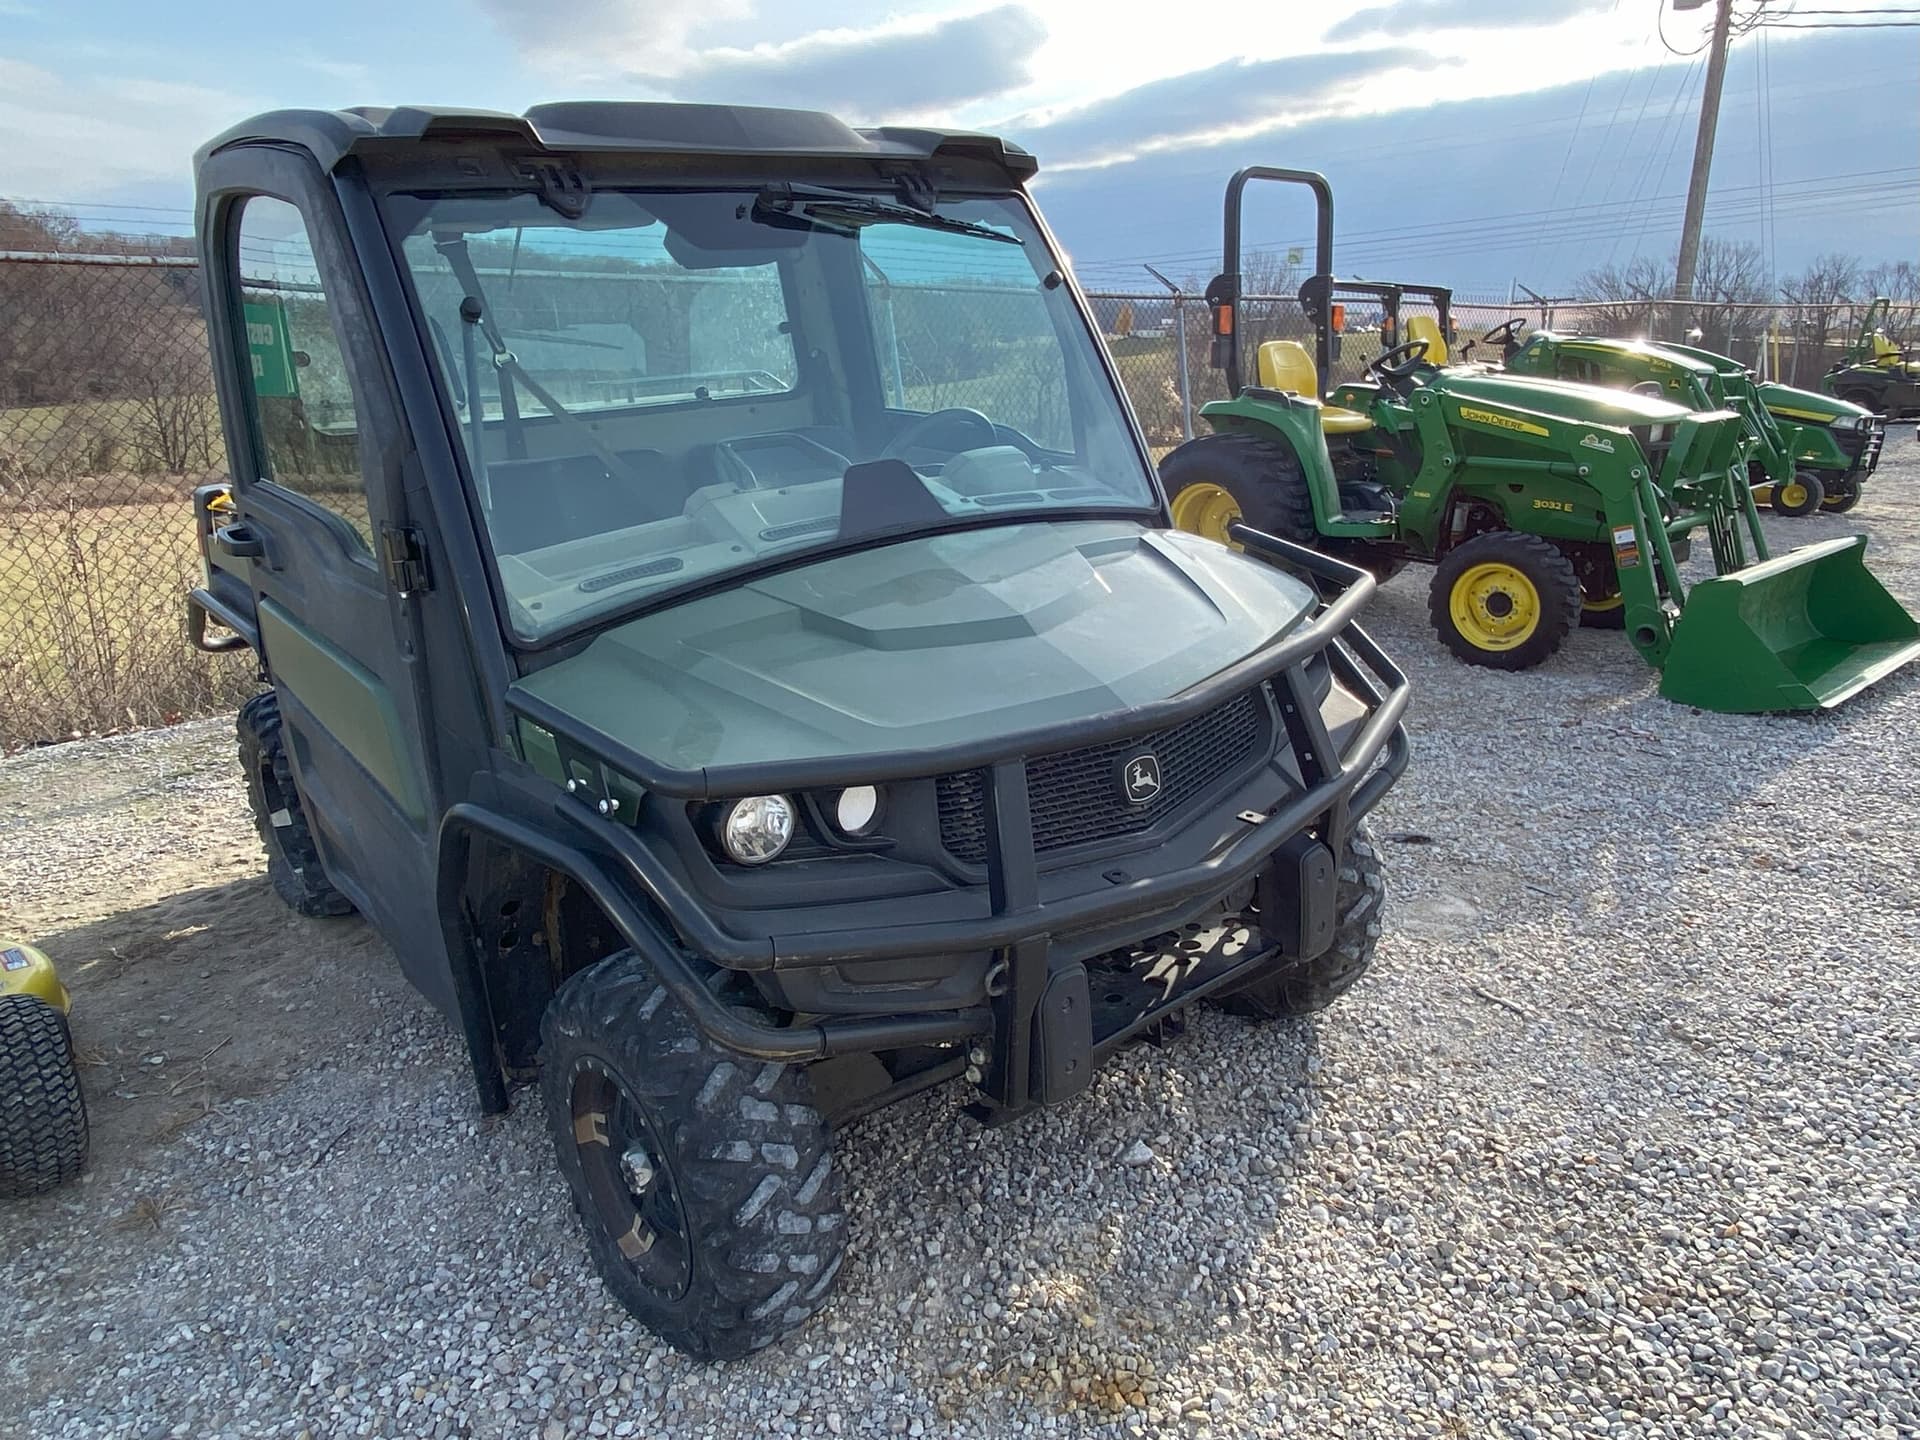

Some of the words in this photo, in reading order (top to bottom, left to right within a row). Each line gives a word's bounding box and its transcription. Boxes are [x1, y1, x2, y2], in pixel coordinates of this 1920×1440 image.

[1463, 410, 1490, 421] JOHN
[1491, 415, 1524, 429] DEERE
[1532, 499, 1562, 510] 3032
[1564, 503, 1574, 513] E
